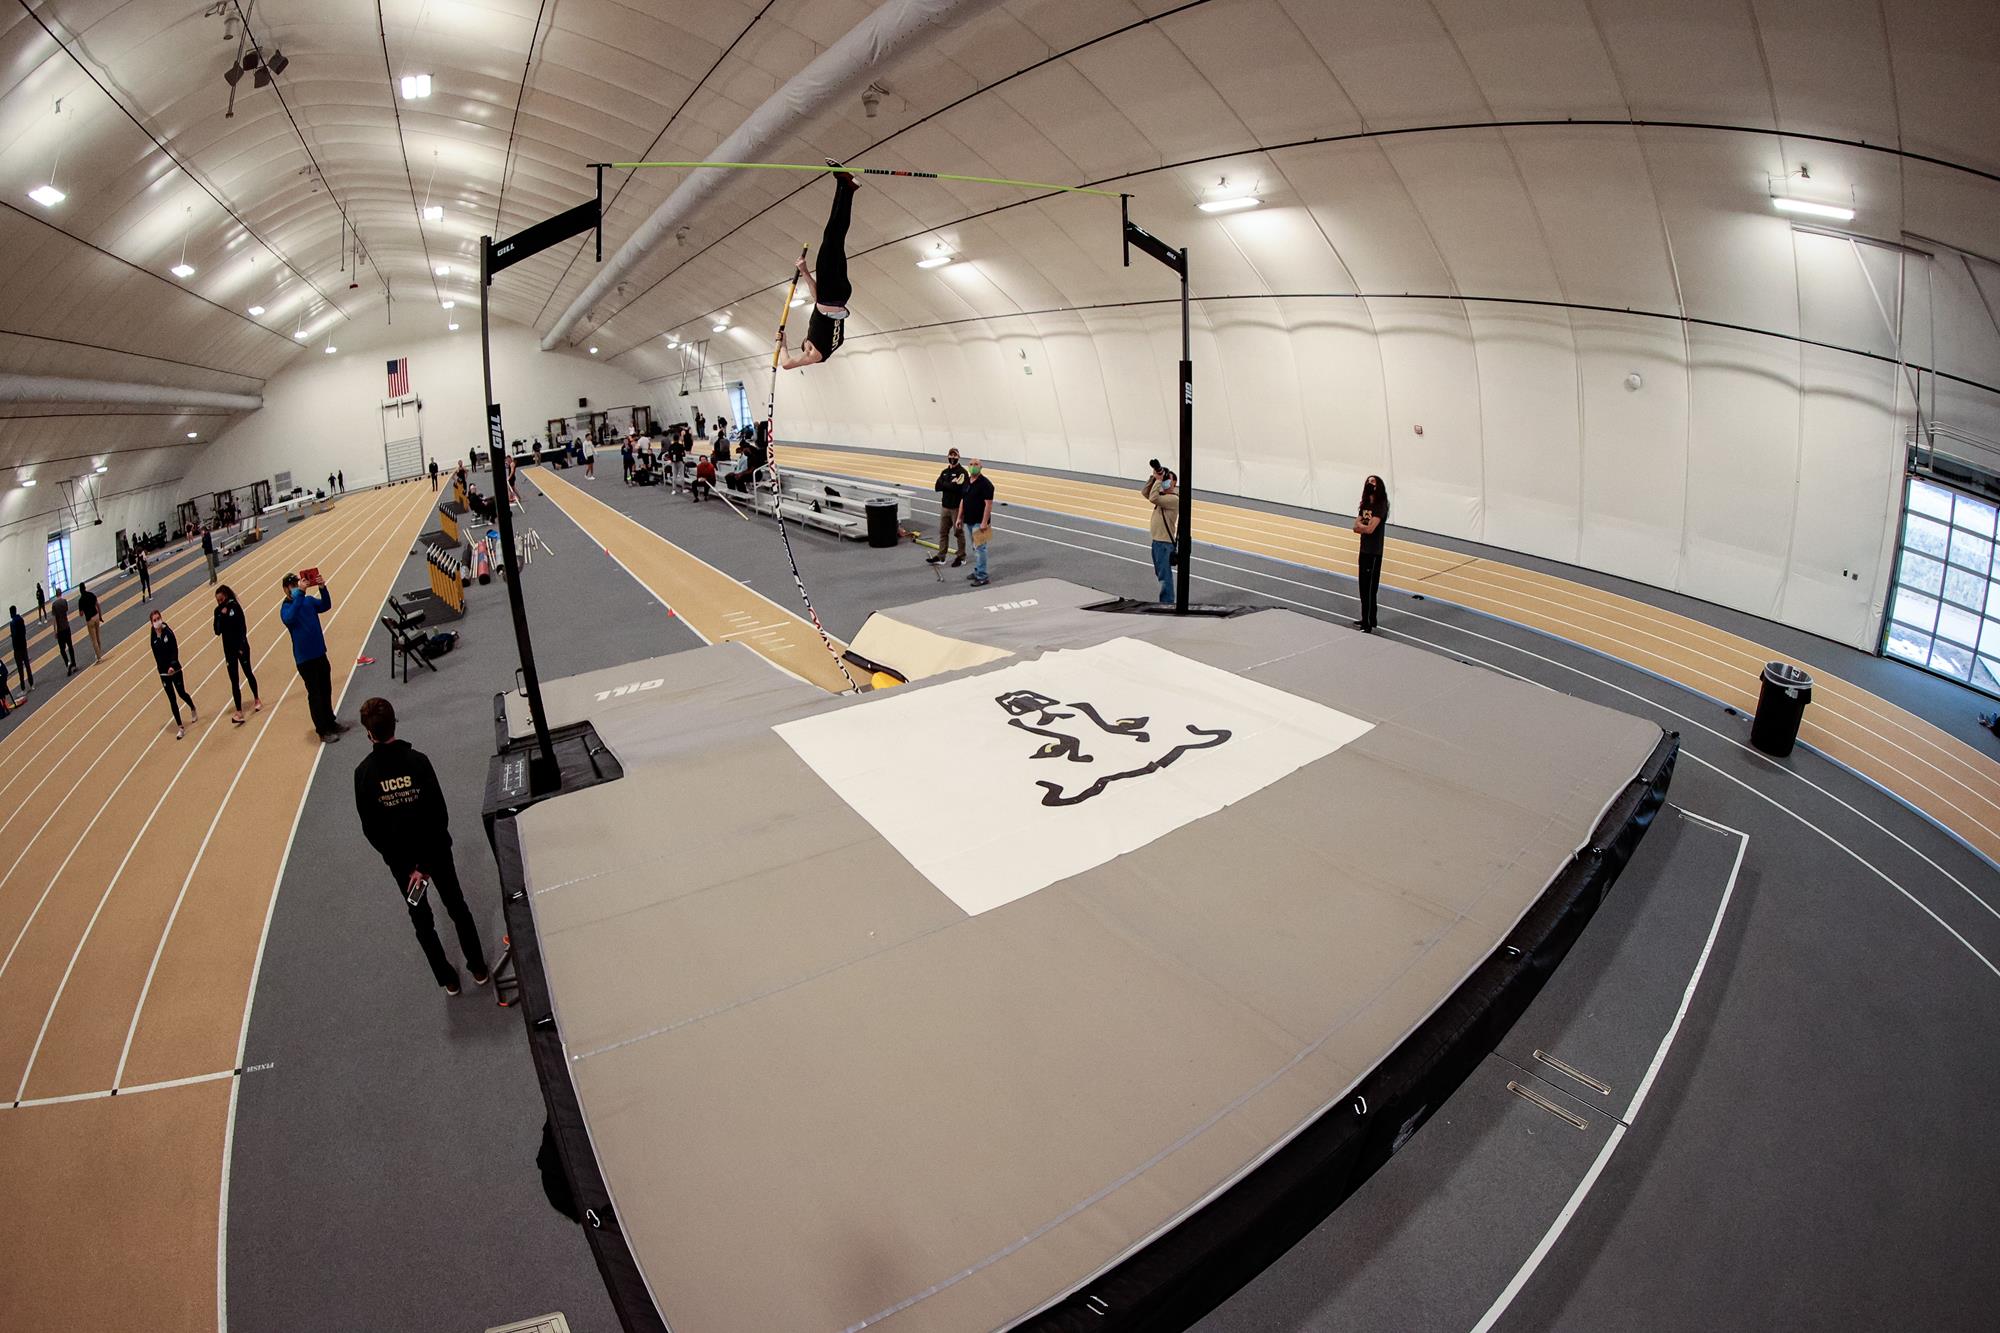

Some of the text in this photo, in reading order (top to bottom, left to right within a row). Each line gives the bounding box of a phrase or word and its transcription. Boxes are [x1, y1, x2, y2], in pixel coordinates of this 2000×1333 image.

[497, 242, 515, 257] GILL
[490, 414, 503, 449] GILL
[983, 598, 1039, 613] GILL
[594, 678, 665, 701] GILL
[380, 776, 412, 792] UCCS
